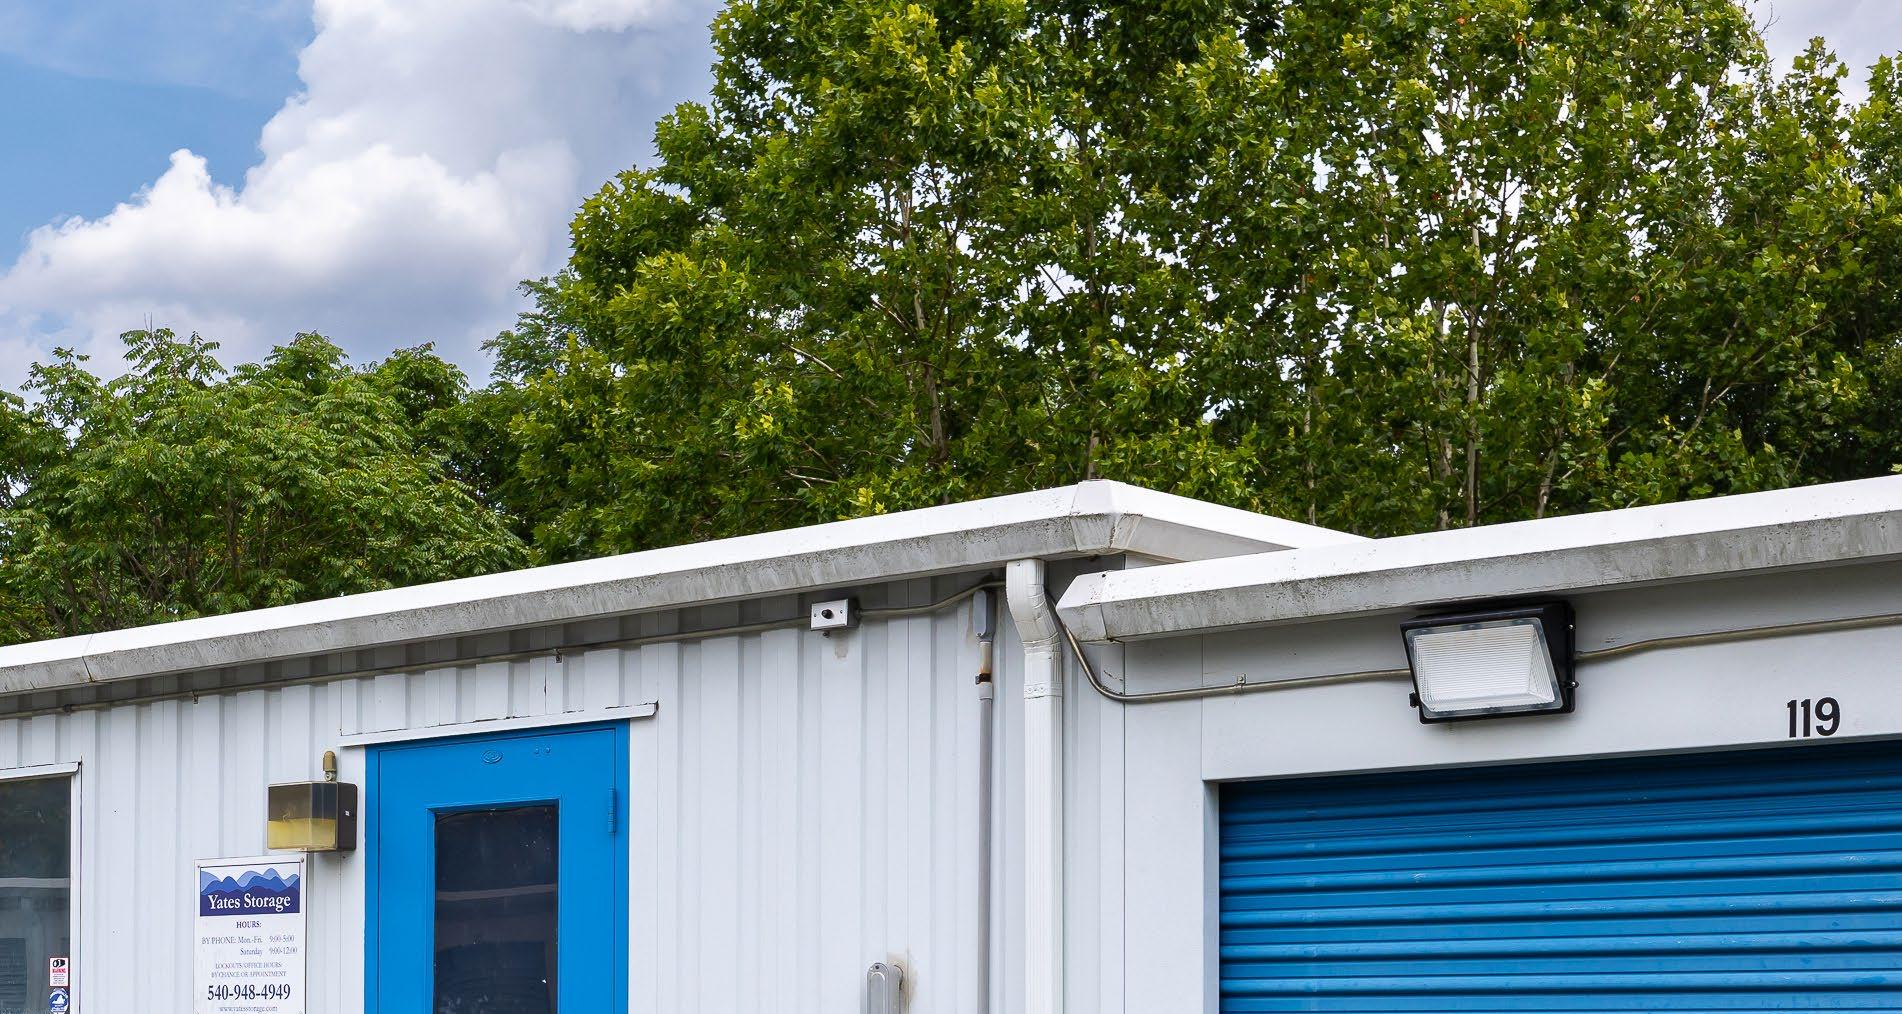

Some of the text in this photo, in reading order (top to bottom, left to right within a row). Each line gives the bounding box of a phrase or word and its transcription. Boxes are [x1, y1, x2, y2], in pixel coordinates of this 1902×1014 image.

[1787, 697, 1840, 738] 119
[208, 893, 291, 912] Yates Storage
[236, 920, 262, 929] HOURS:
[201, 936, 211, 945] BY
[240, 947, 263, 957] Saturday
[207, 983, 291, 1001] 540-948-4949
